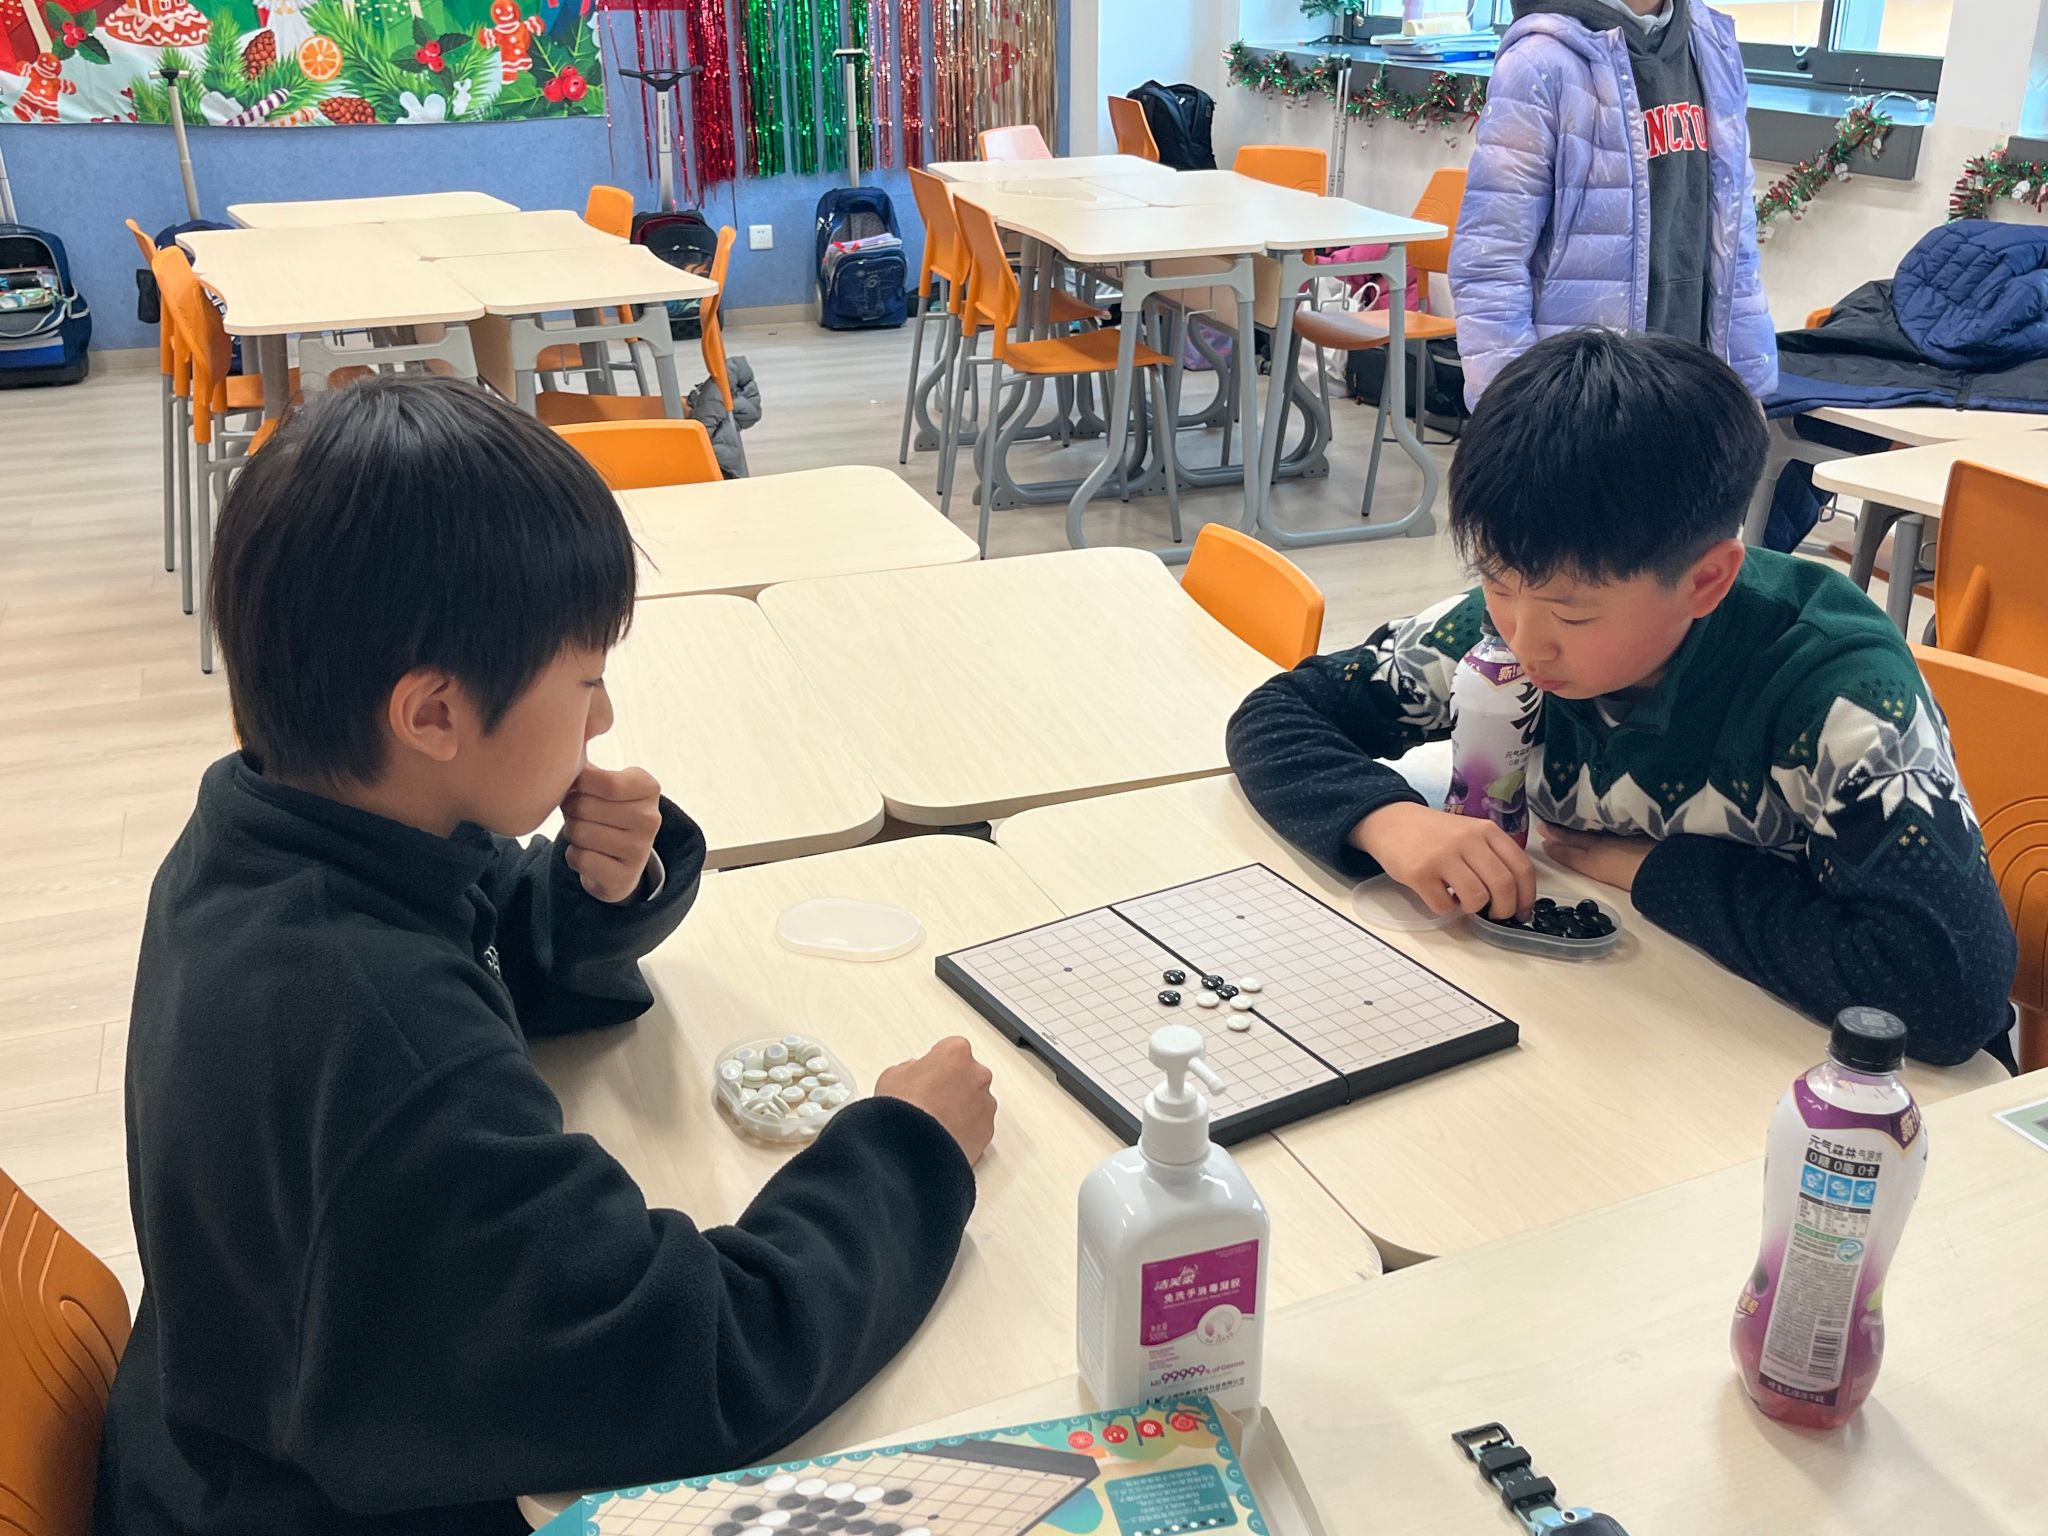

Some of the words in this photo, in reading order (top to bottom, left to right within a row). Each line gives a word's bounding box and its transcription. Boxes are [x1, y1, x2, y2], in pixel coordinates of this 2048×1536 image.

[1641, 101, 1709, 159] NCTO
[1808, 1134, 1857, 1160] 元气森林
[1858, 1165, 1877, 1178] 0卡
[1163, 1277, 1241, 1305] 免洗手消毒凝胶
